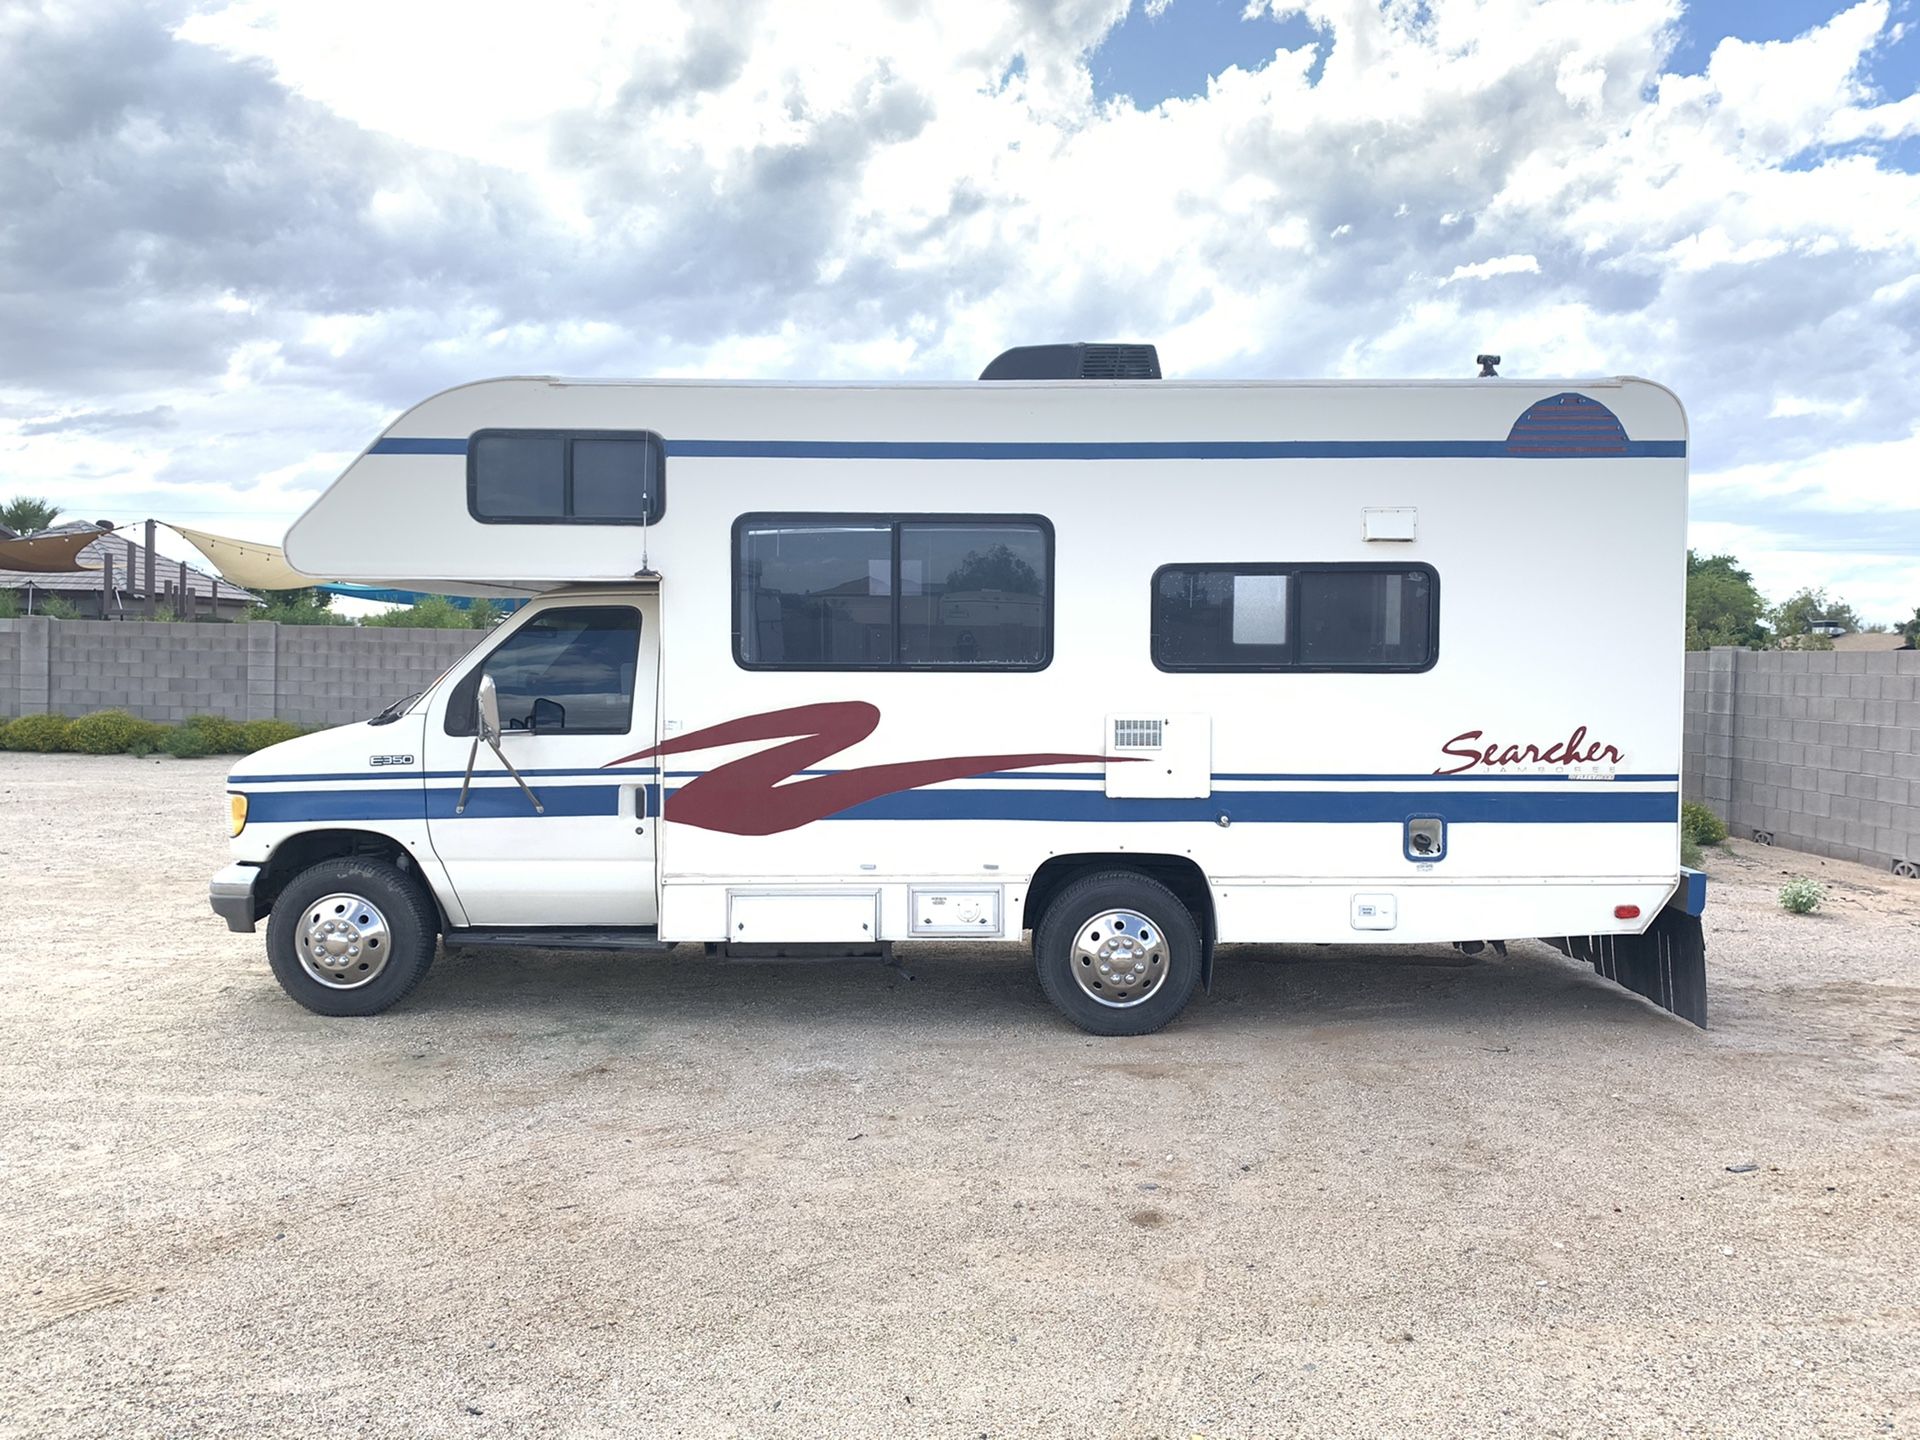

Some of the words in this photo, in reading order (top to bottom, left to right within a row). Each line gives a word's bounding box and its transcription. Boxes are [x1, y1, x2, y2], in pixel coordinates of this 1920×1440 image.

[1432, 726, 1625, 775] Searcher
[370, 755, 414, 766] E350
[1483, 766, 1616, 774] JAMBOREE
